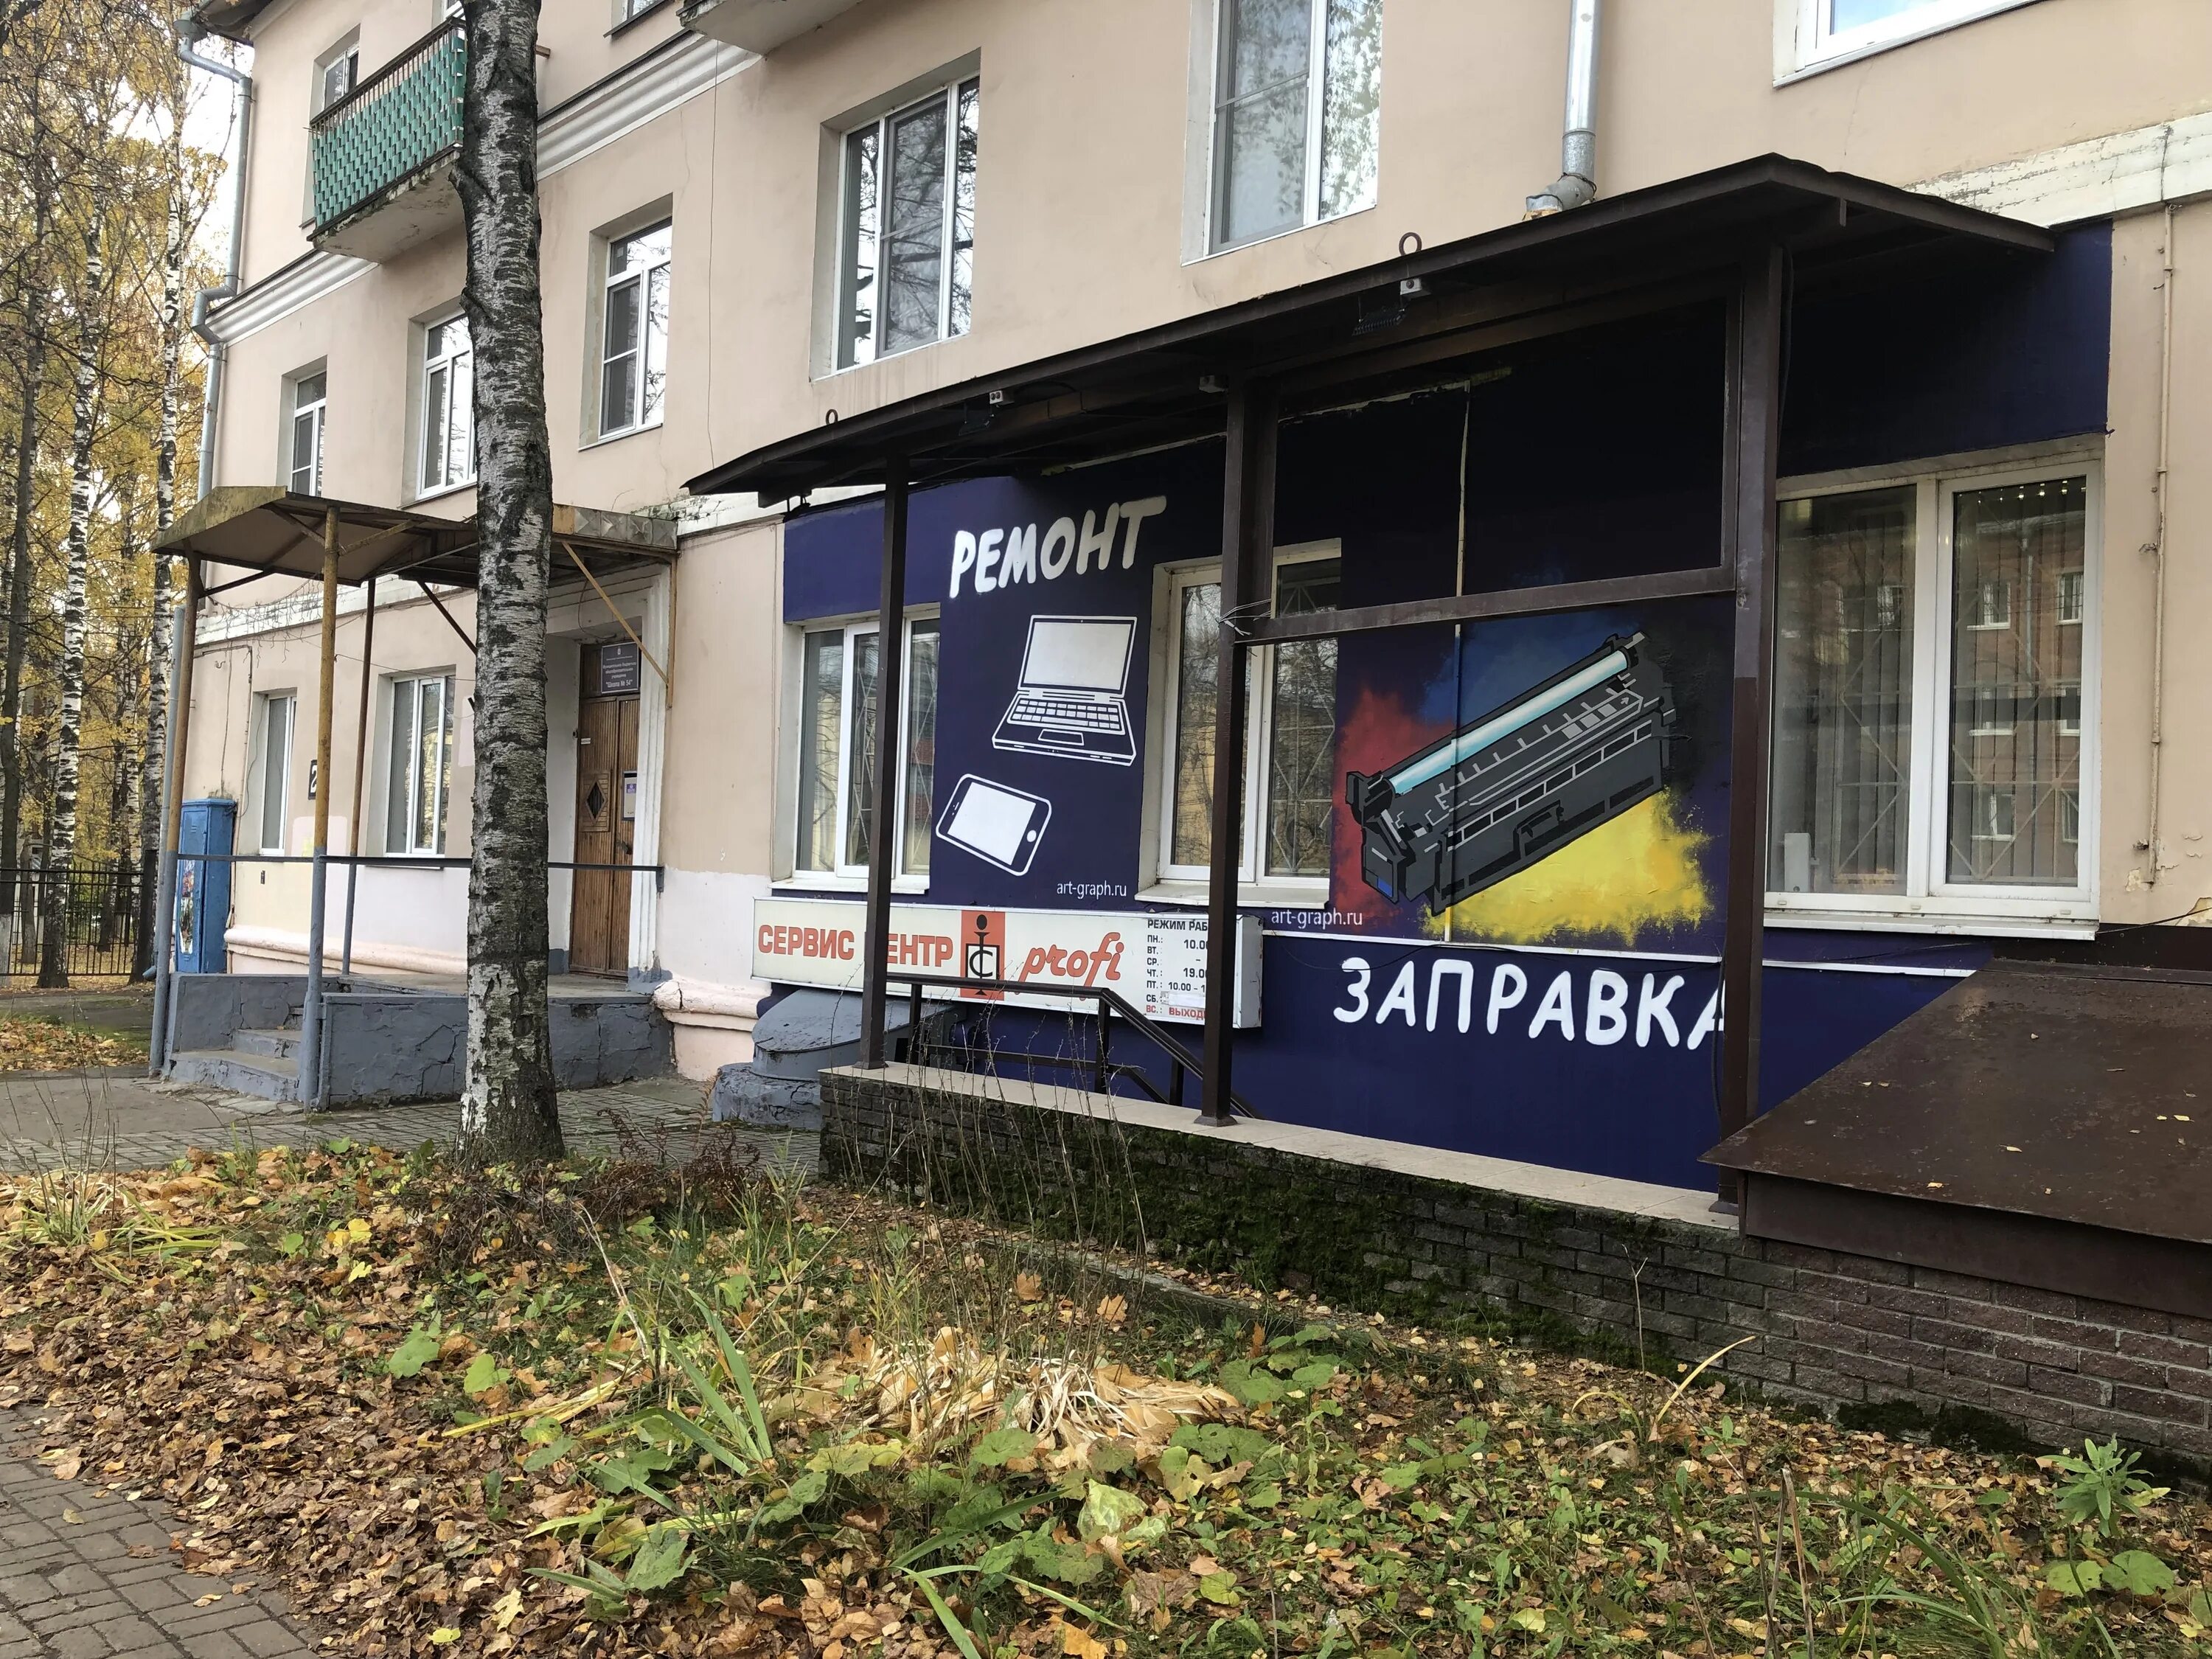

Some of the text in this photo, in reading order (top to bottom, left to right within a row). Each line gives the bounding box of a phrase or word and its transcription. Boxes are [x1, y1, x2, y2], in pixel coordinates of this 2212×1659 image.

[949, 495, 1166, 599] РЕМОНТ
[1057, 880, 1127, 900] art-graph.ru
[1147, 919, 1208, 931] РЕЖИМ РАБ
[1271, 907, 1363, 930] art-graph.ru
[758, 924, 953, 967] СЕРВИС ЕНТР
[1015, 931, 1124, 1001] profi
[1168, 981, 1192, 992] 10.00
[1169, 1006, 1207, 1020] ВЫХОД
[1333, 956, 1726, 1051] ЗАПРАВКА
